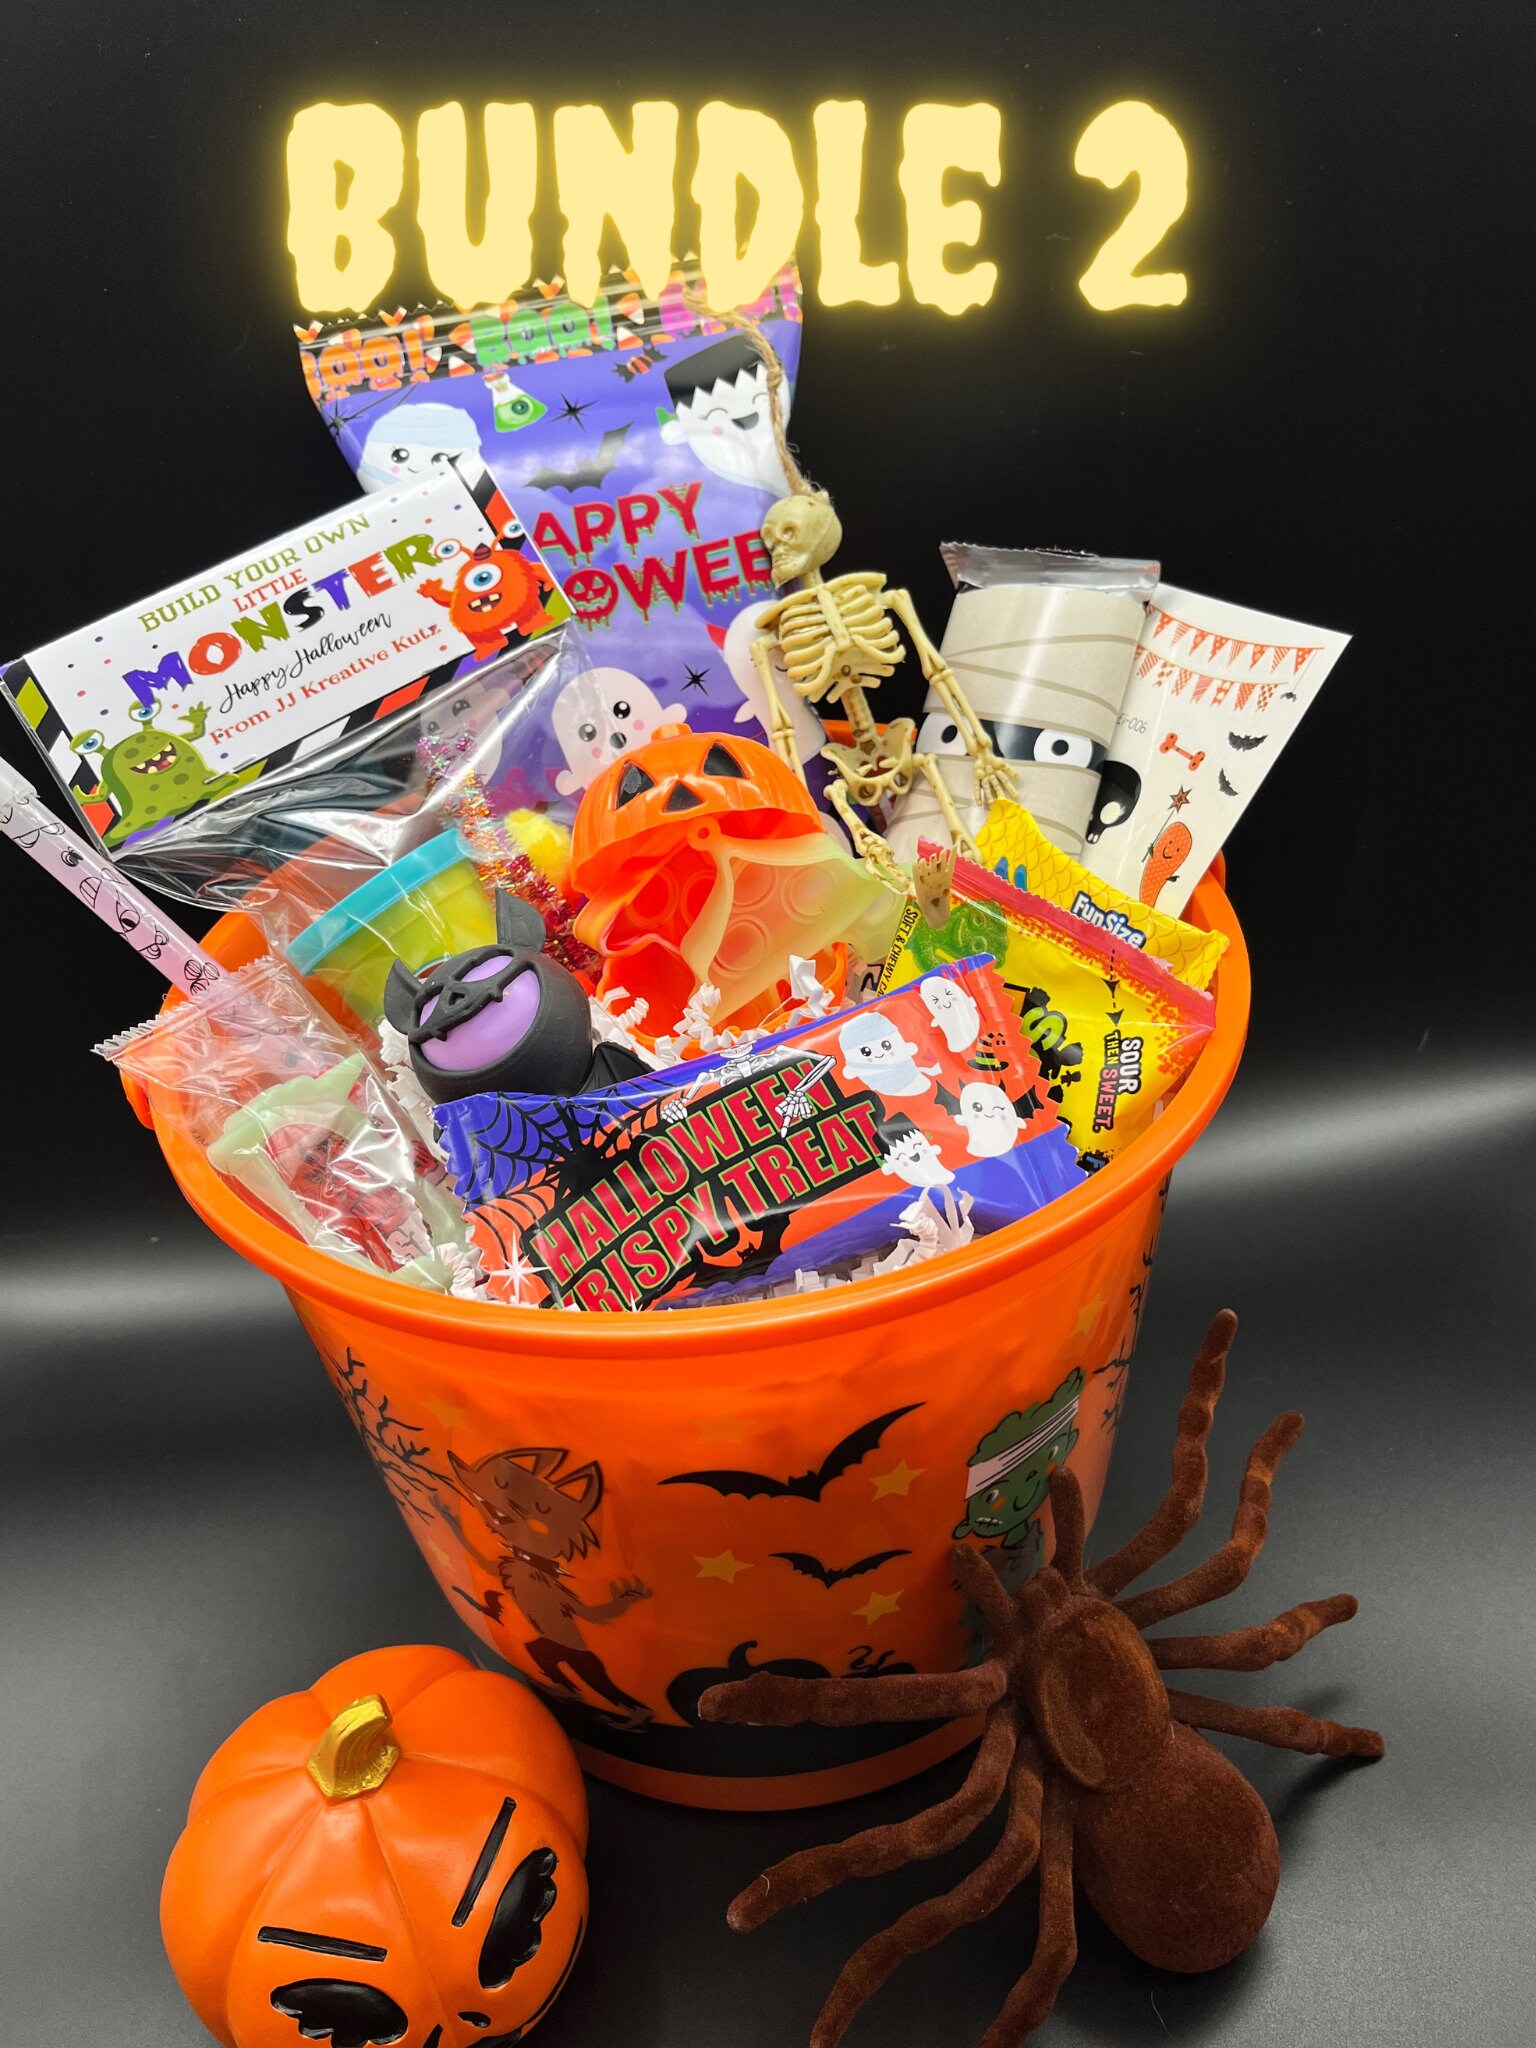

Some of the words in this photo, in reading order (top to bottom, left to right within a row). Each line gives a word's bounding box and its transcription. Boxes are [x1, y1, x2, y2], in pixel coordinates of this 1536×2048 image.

[531, 480, 702, 567] APPY
[138, 583, 222, 632] BUILD
[224, 547, 301, 590] YOUR
[304, 512, 370, 554] OWN
[232, 568, 308, 613] LITTLE
[122, 533, 443, 709] MONSTER
[209, 709, 271, 746] From
[276, 692, 297, 713] JJ
[300, 650, 389, 699] Kreative
[391, 624, 442, 653] Kutz
[219, 664, 289, 714] Happy
[289, 612, 391, 679] Halloween
[895, 934, 906, 944] &
[899, 908, 919, 936] SOFT
[876, 982, 888, 998] CA
[883, 943, 902, 982] CHEWY
[1106, 1031, 1120, 1065] THEN
[1118, 1037, 1142, 1094] SOUR
[1094, 1068, 1119, 1132] SWEET.
[529, 1058, 838, 1287] HALLOWEEN
[719, 1099, 883, 1221] TREAT
